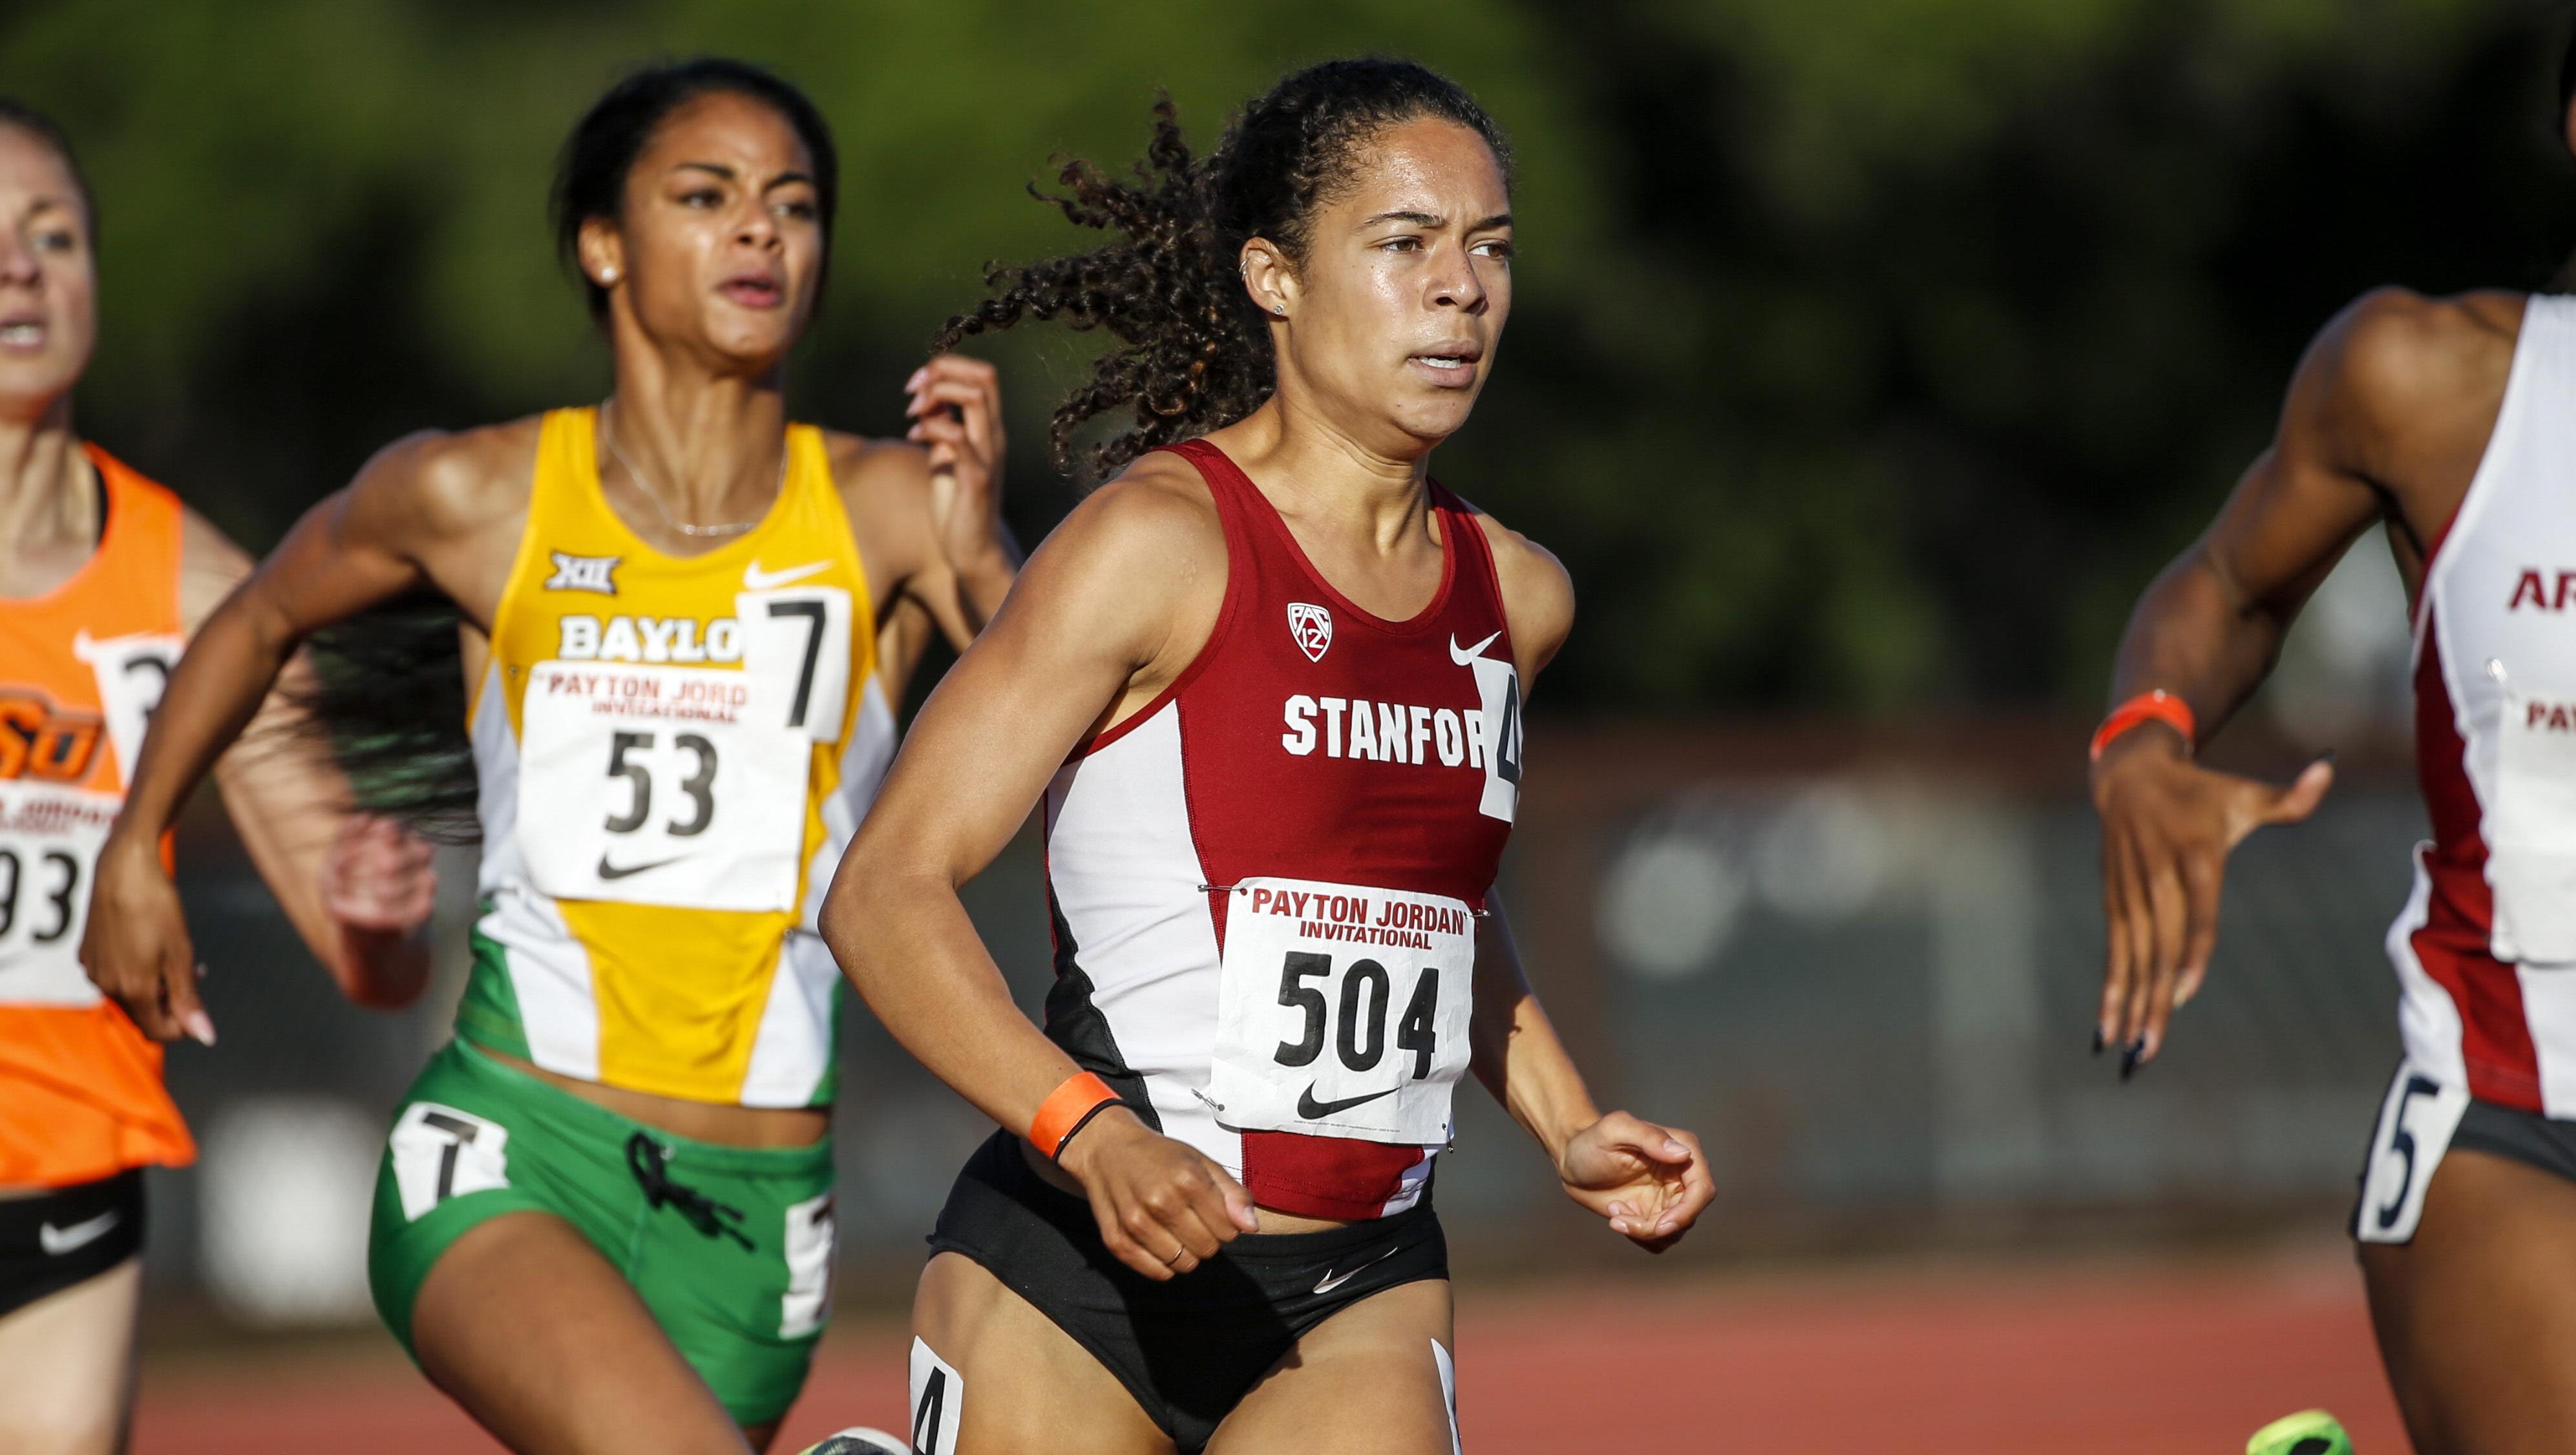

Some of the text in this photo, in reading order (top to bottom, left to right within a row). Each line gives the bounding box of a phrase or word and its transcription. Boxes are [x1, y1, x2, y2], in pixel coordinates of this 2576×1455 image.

[1291, 606, 1330, 641] PAC
[1302, 627, 1325, 649] 12
[768, 600, 825, 727] 7
[549, 674, 660, 699] PAYTON
[2526, 702, 2576, 730] PA
[605, 732, 718, 836] 53
[1252, 888, 1464, 936] PAYTON JORDAN
[1299, 921, 1432, 950] INVITATIONAL
[1274, 950, 1439, 1080] 504
[2379, 1076, 2440, 1228] 5
